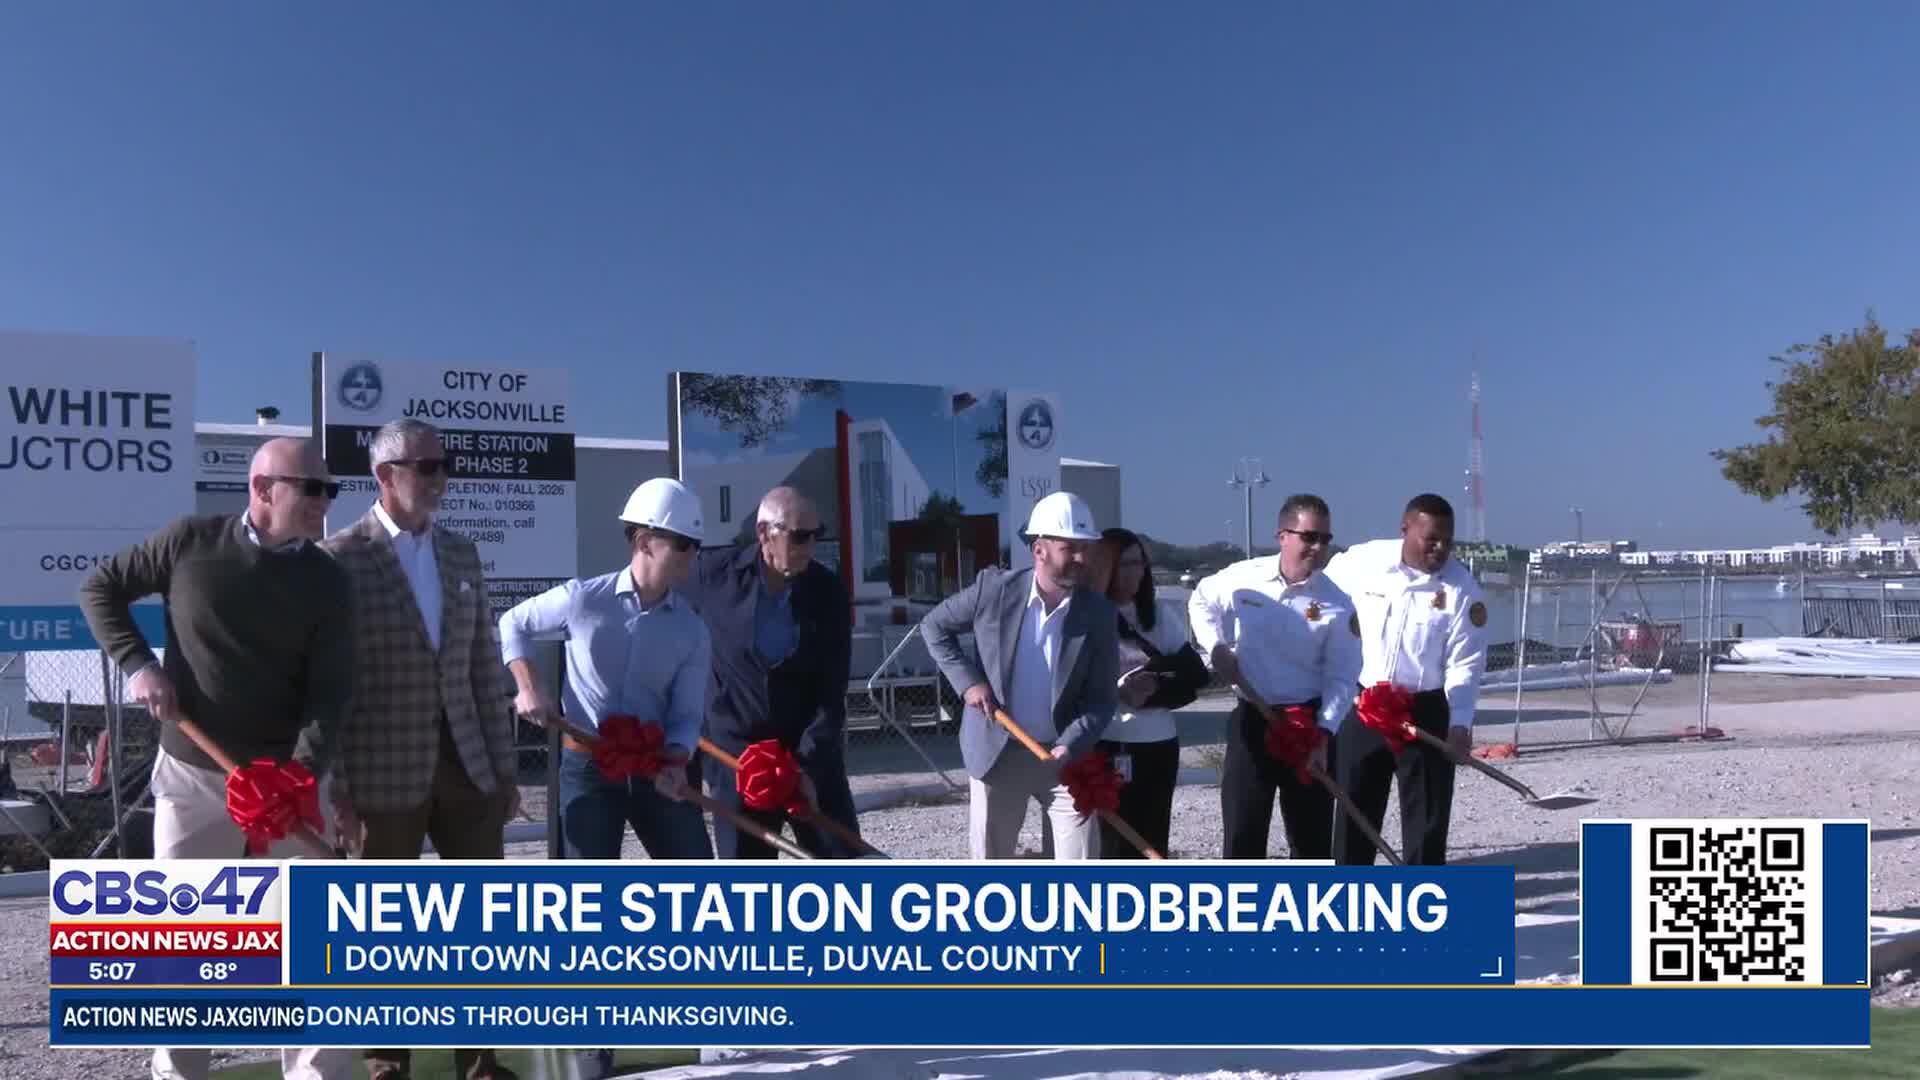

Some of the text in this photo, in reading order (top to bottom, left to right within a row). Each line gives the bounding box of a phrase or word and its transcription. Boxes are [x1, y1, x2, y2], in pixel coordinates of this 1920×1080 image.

[443, 370, 527, 392] CITY OF
[8, 386, 173, 429] WHITE
[402, 398, 566, 423] JACKSONVILLE
[478, 435, 549, 453] STATION
[0, 436, 173, 473] UCTORS
[455, 456, 529, 473] PHASE 2
[340, 480, 378, 491] ESTIM
[447, 482, 504, 494] PLETION:
[506, 483, 536, 495] FALL
[440, 499, 465, 511] ECT
[513, 517, 536, 529] call
